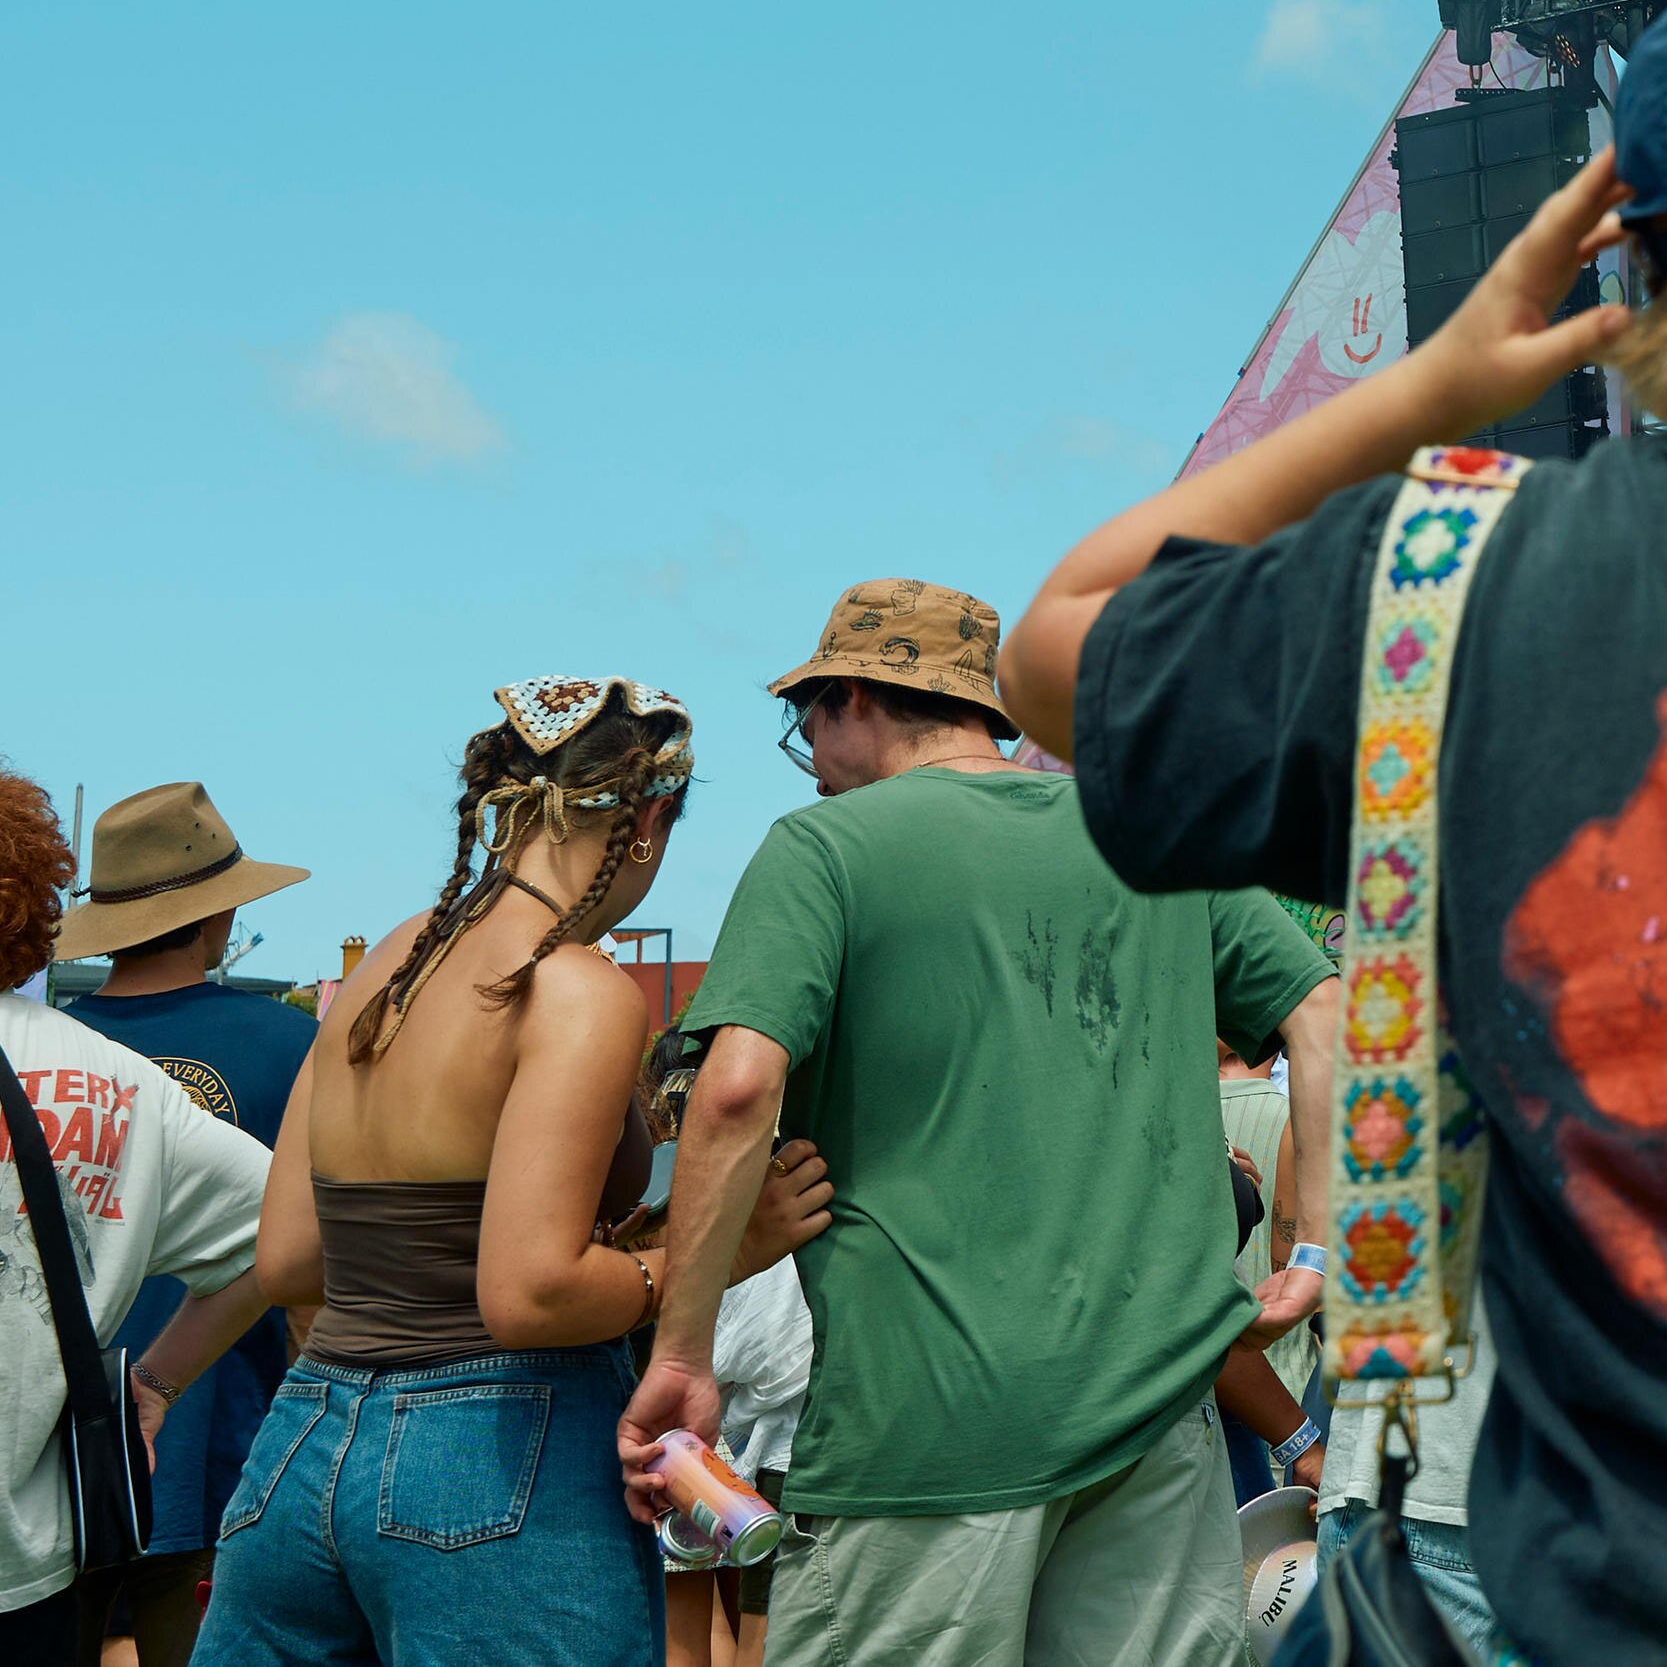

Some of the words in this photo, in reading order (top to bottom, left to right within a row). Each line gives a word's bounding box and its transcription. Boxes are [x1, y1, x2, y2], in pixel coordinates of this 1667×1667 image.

[163, 1062, 230, 1114] EVERYDAY
[1289, 1433, 1309, 1451] 18+
[1260, 1559, 1297, 1627] MALIBU
